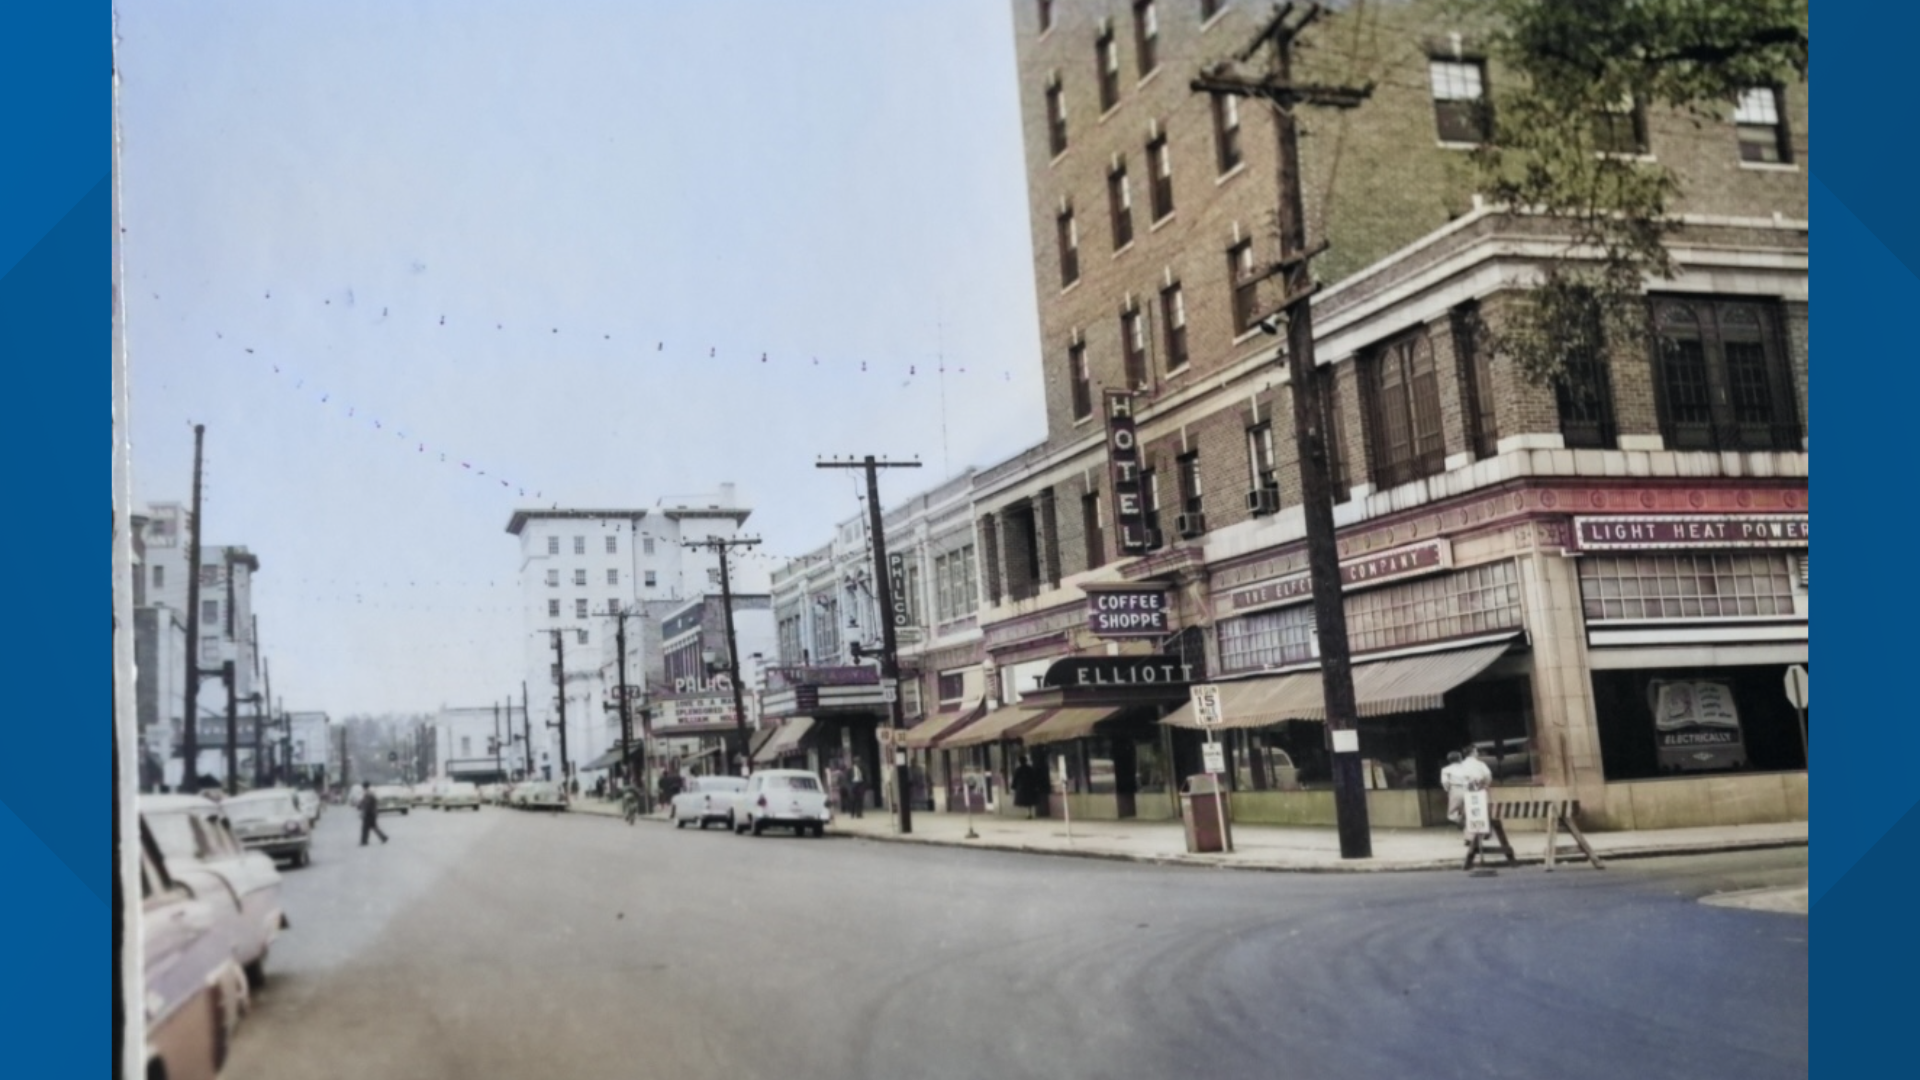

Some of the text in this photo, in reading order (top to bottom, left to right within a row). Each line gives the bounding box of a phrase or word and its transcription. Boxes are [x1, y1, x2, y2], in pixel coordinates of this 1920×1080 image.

[1111, 396, 1142, 547] HOTEL
[1592, 522, 1808, 540] LIGHT HEAT POWER
[1244, 552, 1420, 604] THE ELECT COMPANY
[891, 556, 906, 626] PHILCO
[1098, 594, 1159, 610] COFFEE
[1099, 612, 1161, 629] SHOPPE
[675, 674, 735, 694] PALAC
[1077, 664, 1194, 685] ELLIOTT
[1197, 695, 1215, 707] 15
[1664, 732, 1731, 744] ELECTRICALLY
